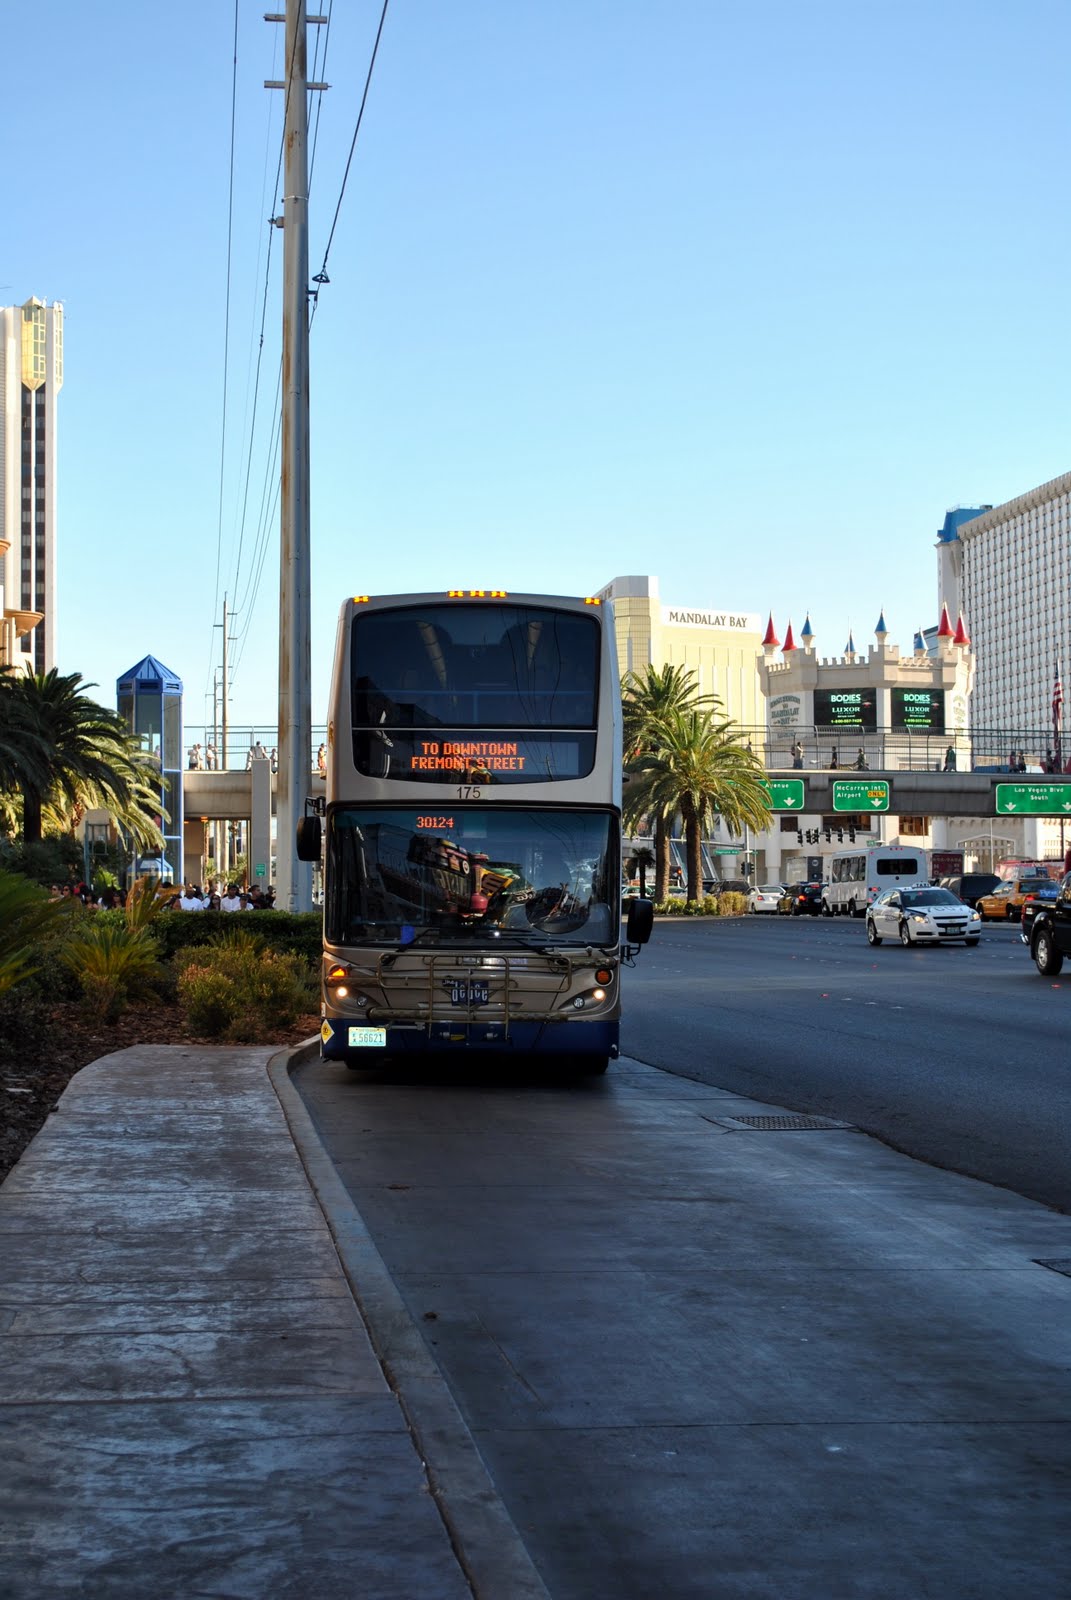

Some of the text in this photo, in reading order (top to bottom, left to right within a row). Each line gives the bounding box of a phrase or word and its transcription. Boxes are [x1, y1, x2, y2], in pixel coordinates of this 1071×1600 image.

[669, 611, 747, 628] MANDALAY BAY
[831, 693, 861, 702] BODIES
[904, 693, 931, 702] BODIES
[421, 742, 517, 755] TO DOWNTOWN
[411, 756, 525, 770] FREMONT STREET
[456, 786, 481, 799] 175
[416, 816, 455, 828] 30124
